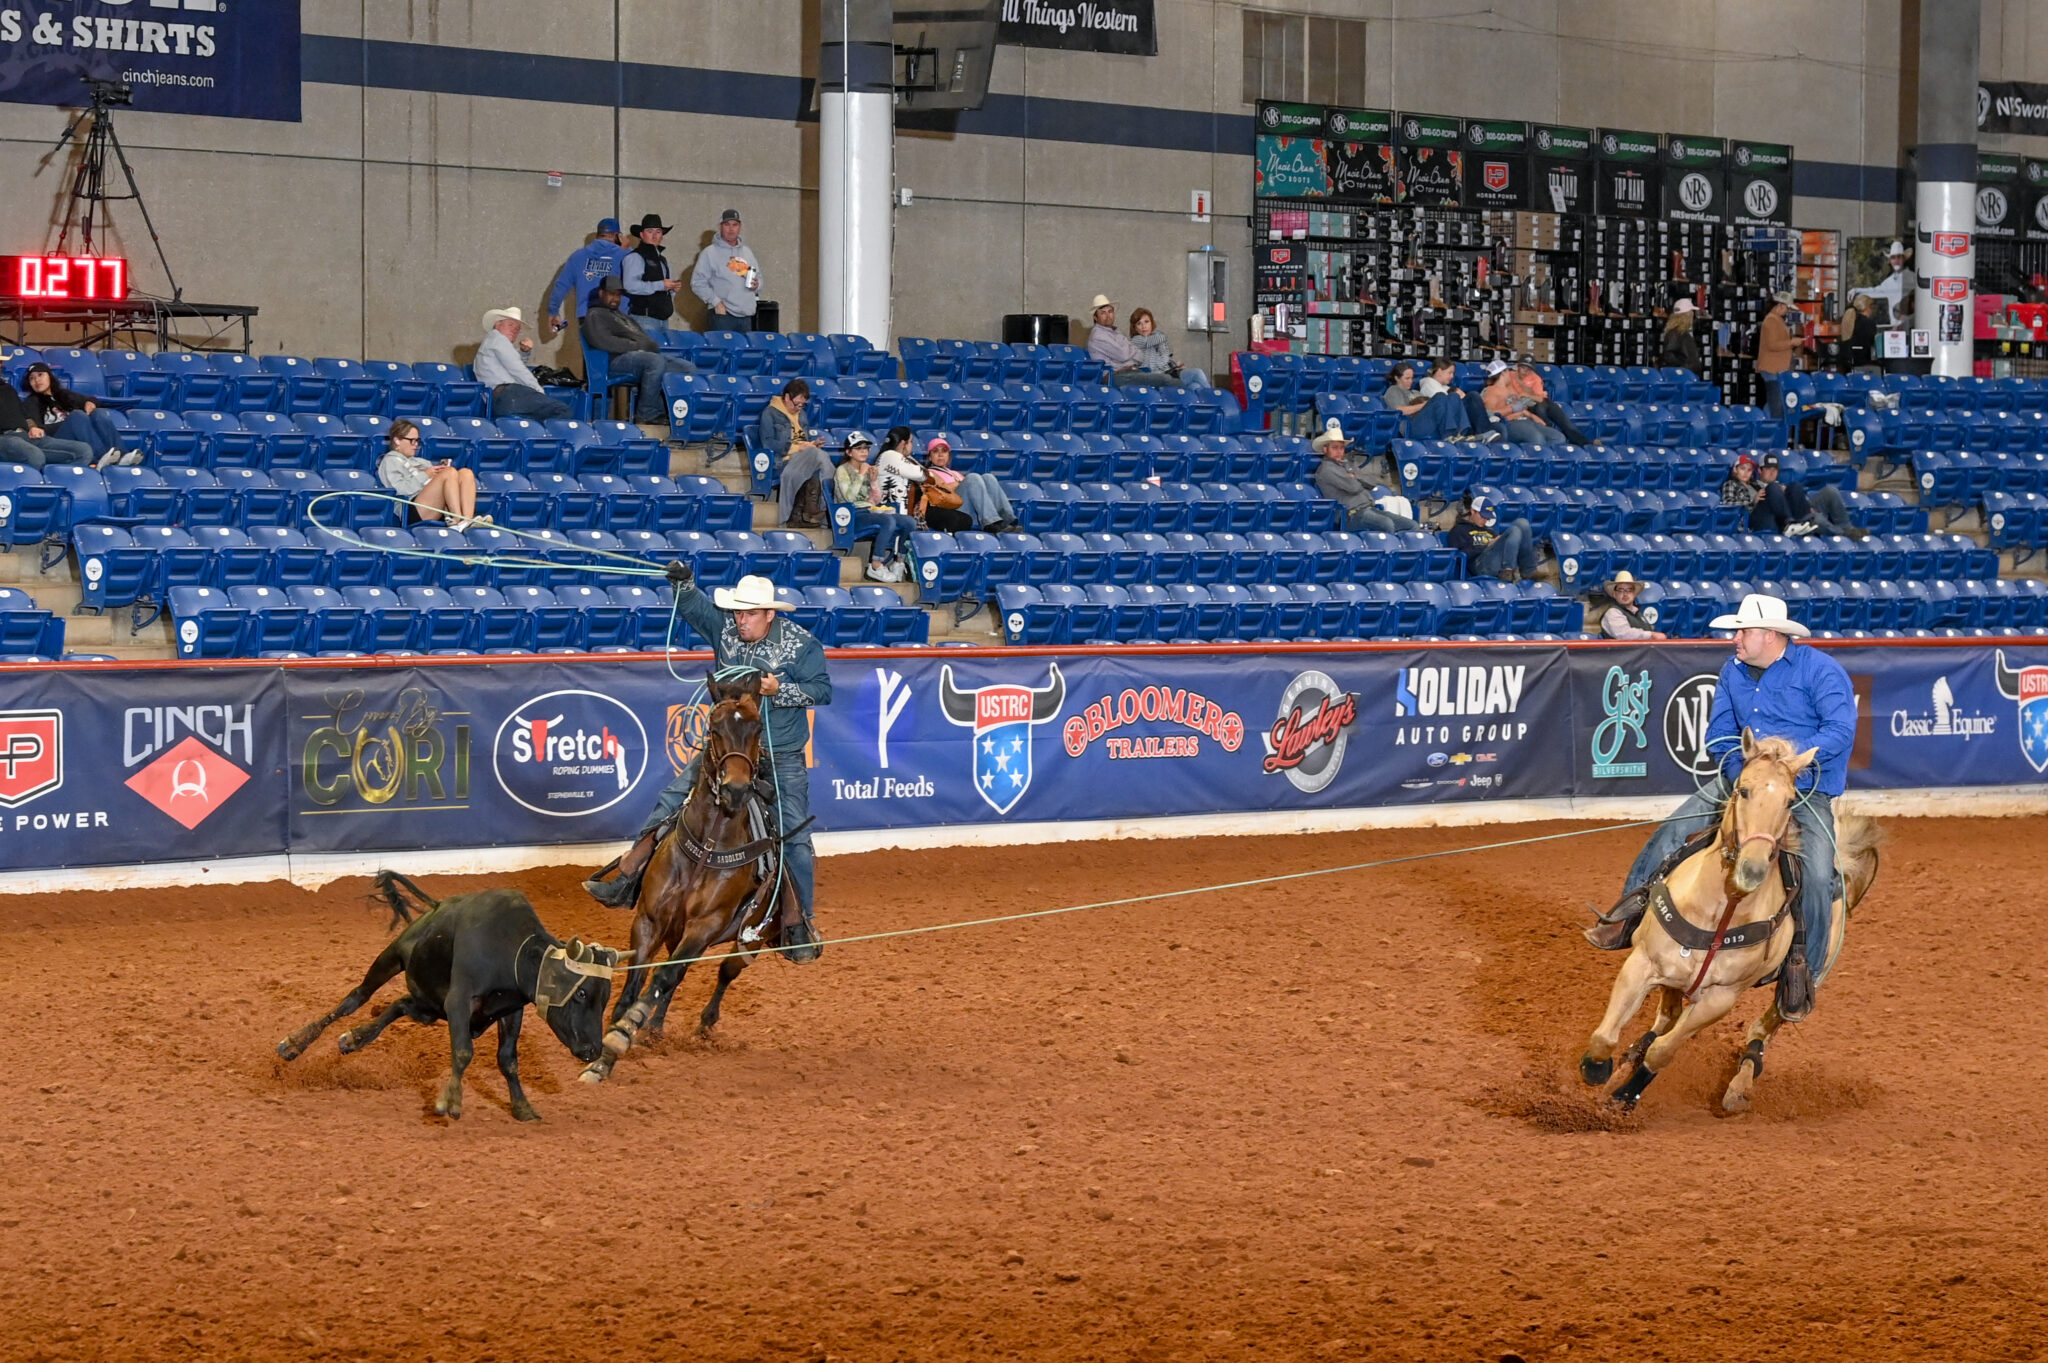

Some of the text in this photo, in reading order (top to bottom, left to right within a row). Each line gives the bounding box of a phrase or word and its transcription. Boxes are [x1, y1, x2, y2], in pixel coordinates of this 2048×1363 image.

[1023, 0, 1075, 34] Things
[1078, 2, 1138, 32] Western
[73, 15, 215, 57] SHIRTS
[122, 68, 214, 88] cinchjeans.com
[1685, 178, 1707, 206] NRS
[1750, 184, 1772, 212] NRS
[1981, 192, 2001, 219] NRS
[1395, 665, 1526, 717] HOLIDAY
[2022, 673, 2048, 693] USTR
[981, 694, 1029, 718] USTRC
[1084, 686, 1223, 742] BLOOMER
[1592, 666, 1652, 765] Gist
[124, 704, 254, 767] CINCH
[1395, 722, 1528, 746] AUTO GROUP
[1891, 708, 1995, 741] Classic Equine
[1106, 736, 1199, 759] TRAILERS
[552, 764, 615, 776] ROPING DUMMIES
[1470, 774, 1492, 788] Jeep
[832, 775, 934, 801] Total Feeds
[16, 812, 110, 831] POWER
